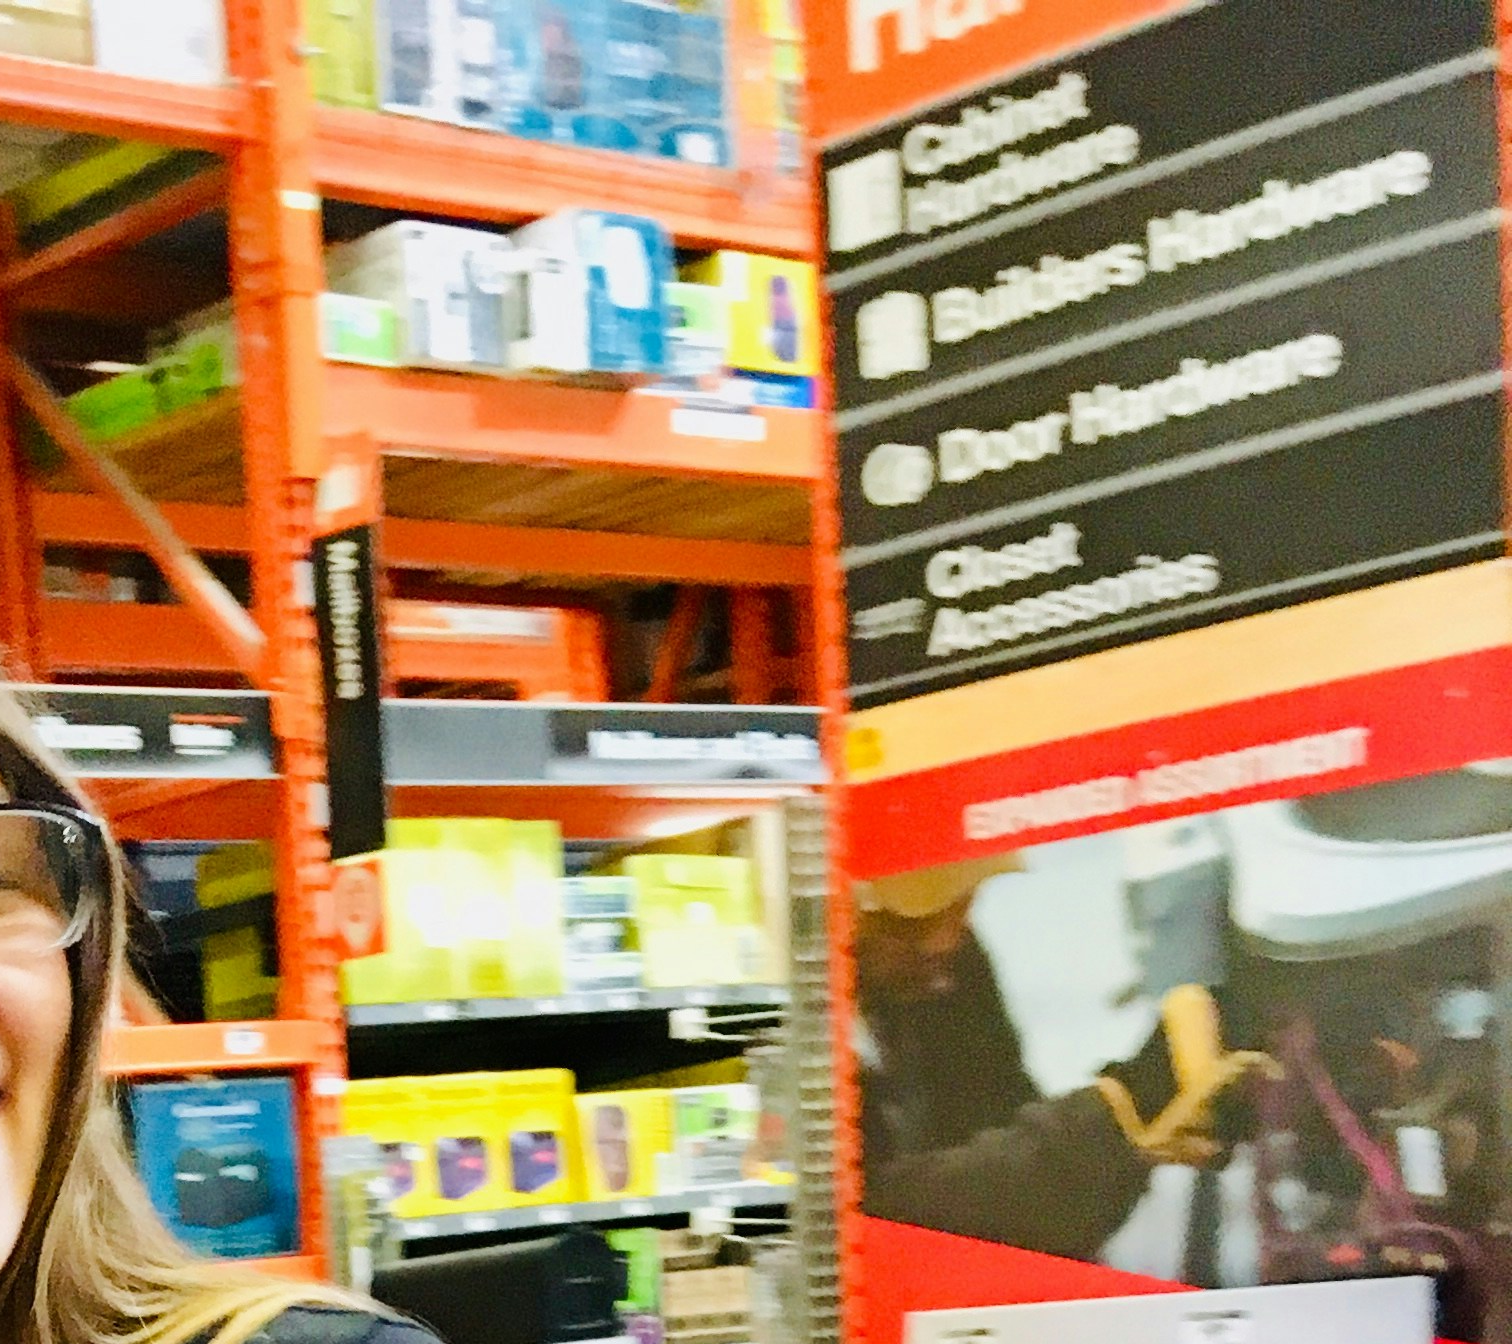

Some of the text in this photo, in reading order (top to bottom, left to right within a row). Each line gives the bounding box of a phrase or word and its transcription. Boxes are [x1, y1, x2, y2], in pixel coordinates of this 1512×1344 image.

[902, 71, 1091, 175] Cabinet
[932, 150, 1433, 343] Builders Hardware
[937, 333, 1344, 484] Door Hardware
[926, 553, 1220, 656] Accessories
